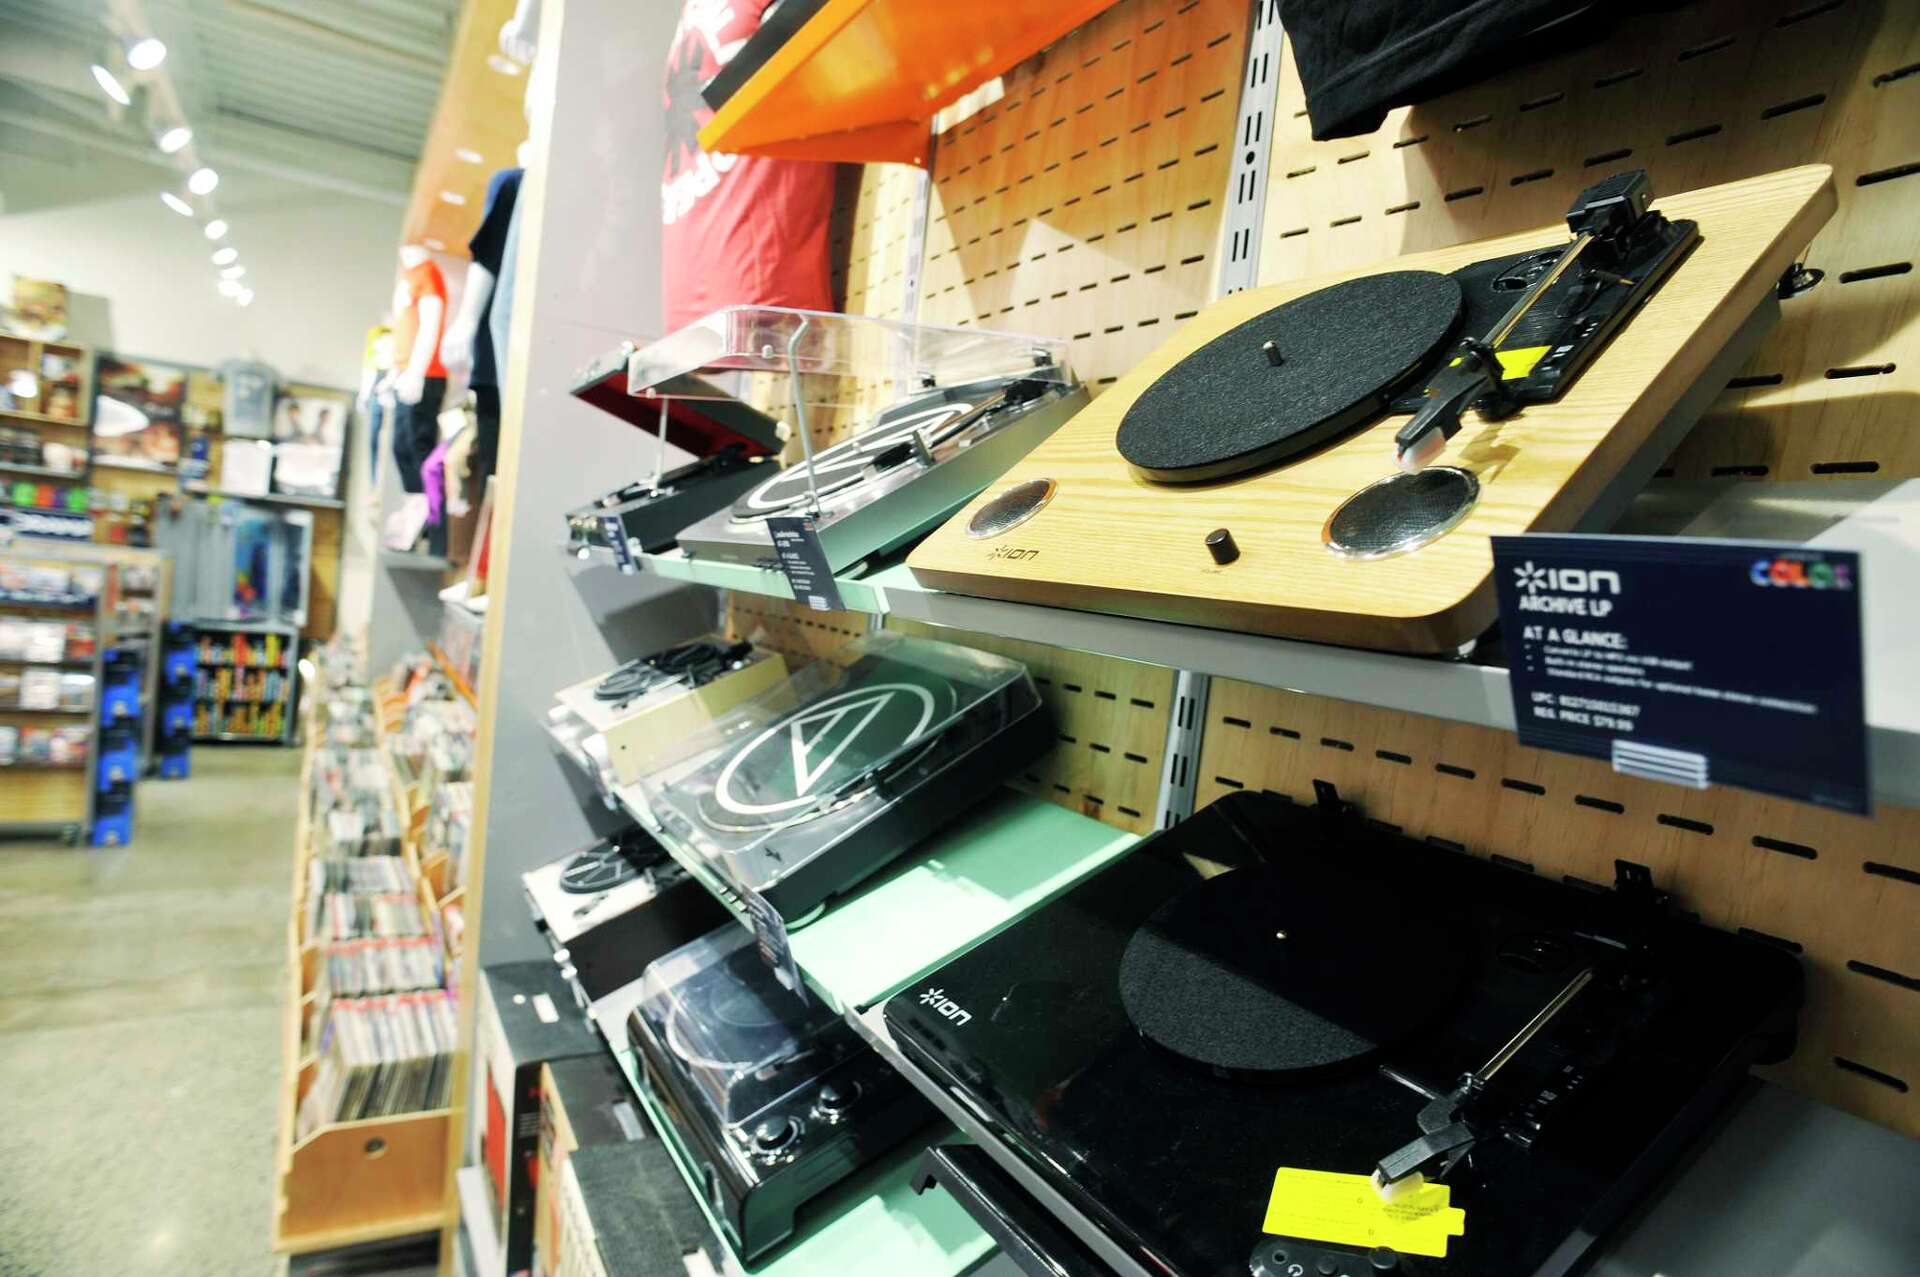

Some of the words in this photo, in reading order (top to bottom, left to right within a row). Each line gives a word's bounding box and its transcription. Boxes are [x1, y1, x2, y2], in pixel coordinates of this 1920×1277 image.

[1519, 595, 1587, 616] ARCHIVE
[1590, 599, 1613, 617] LP
[1523, 625, 1543, 641] AT
[1547, 627, 1561, 643] A
